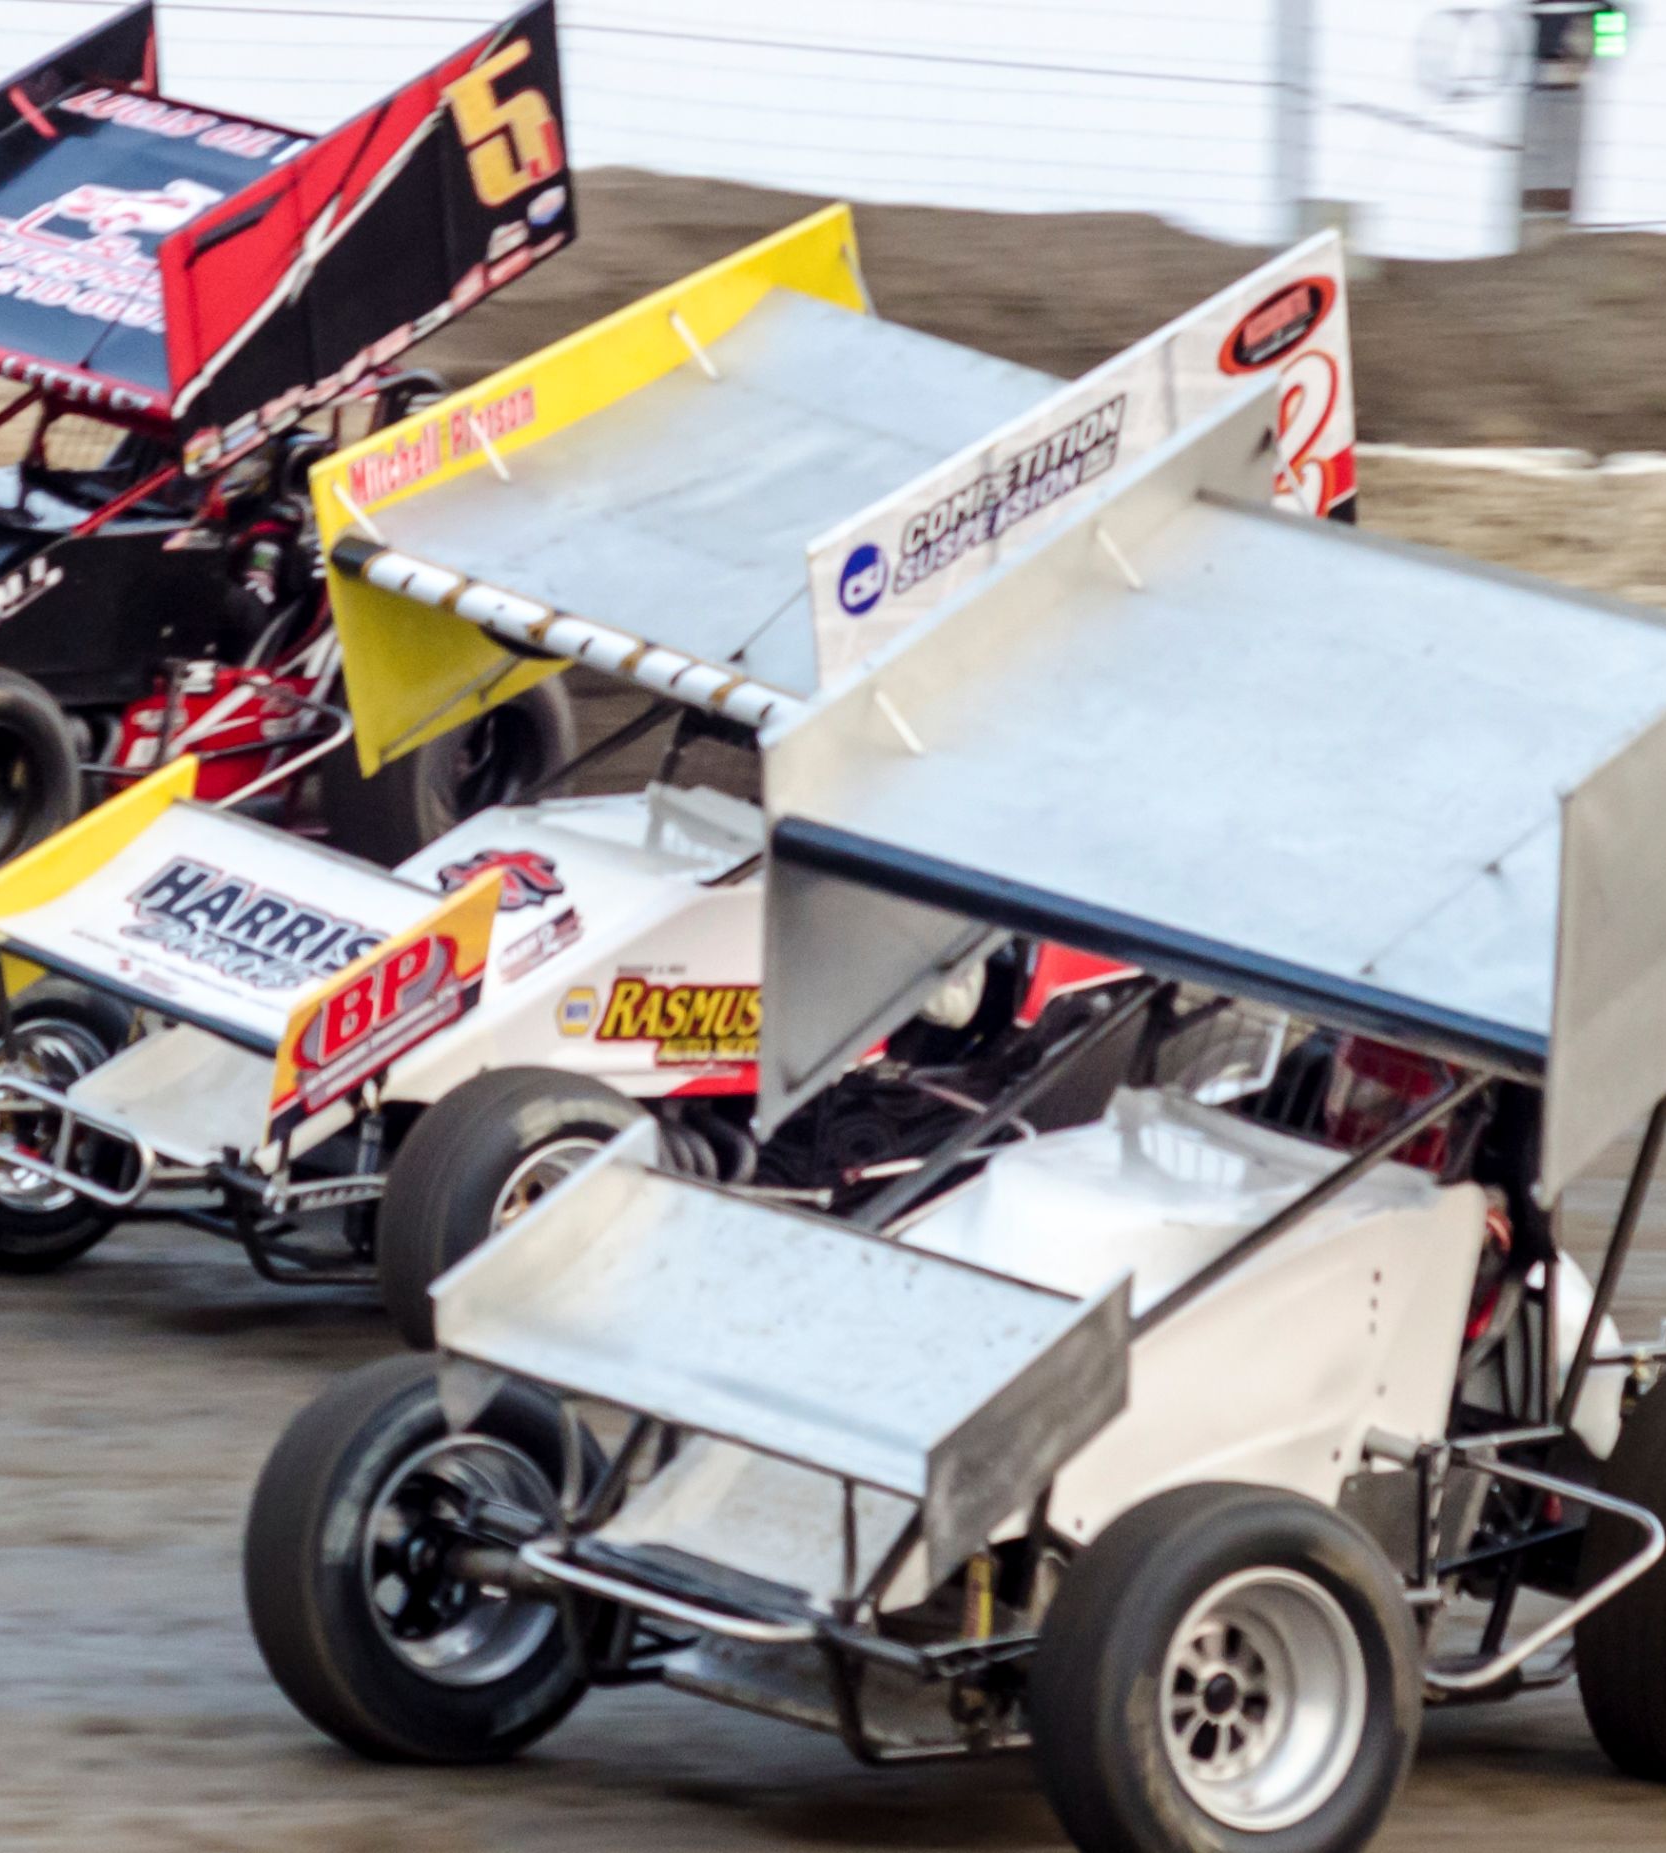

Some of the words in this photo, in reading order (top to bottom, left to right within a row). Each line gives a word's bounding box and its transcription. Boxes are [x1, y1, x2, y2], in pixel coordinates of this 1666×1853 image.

[441, 33, 565, 208] 5
[129, 857, 391, 974] HARRIS
[317, 930, 436, 1067] BP
